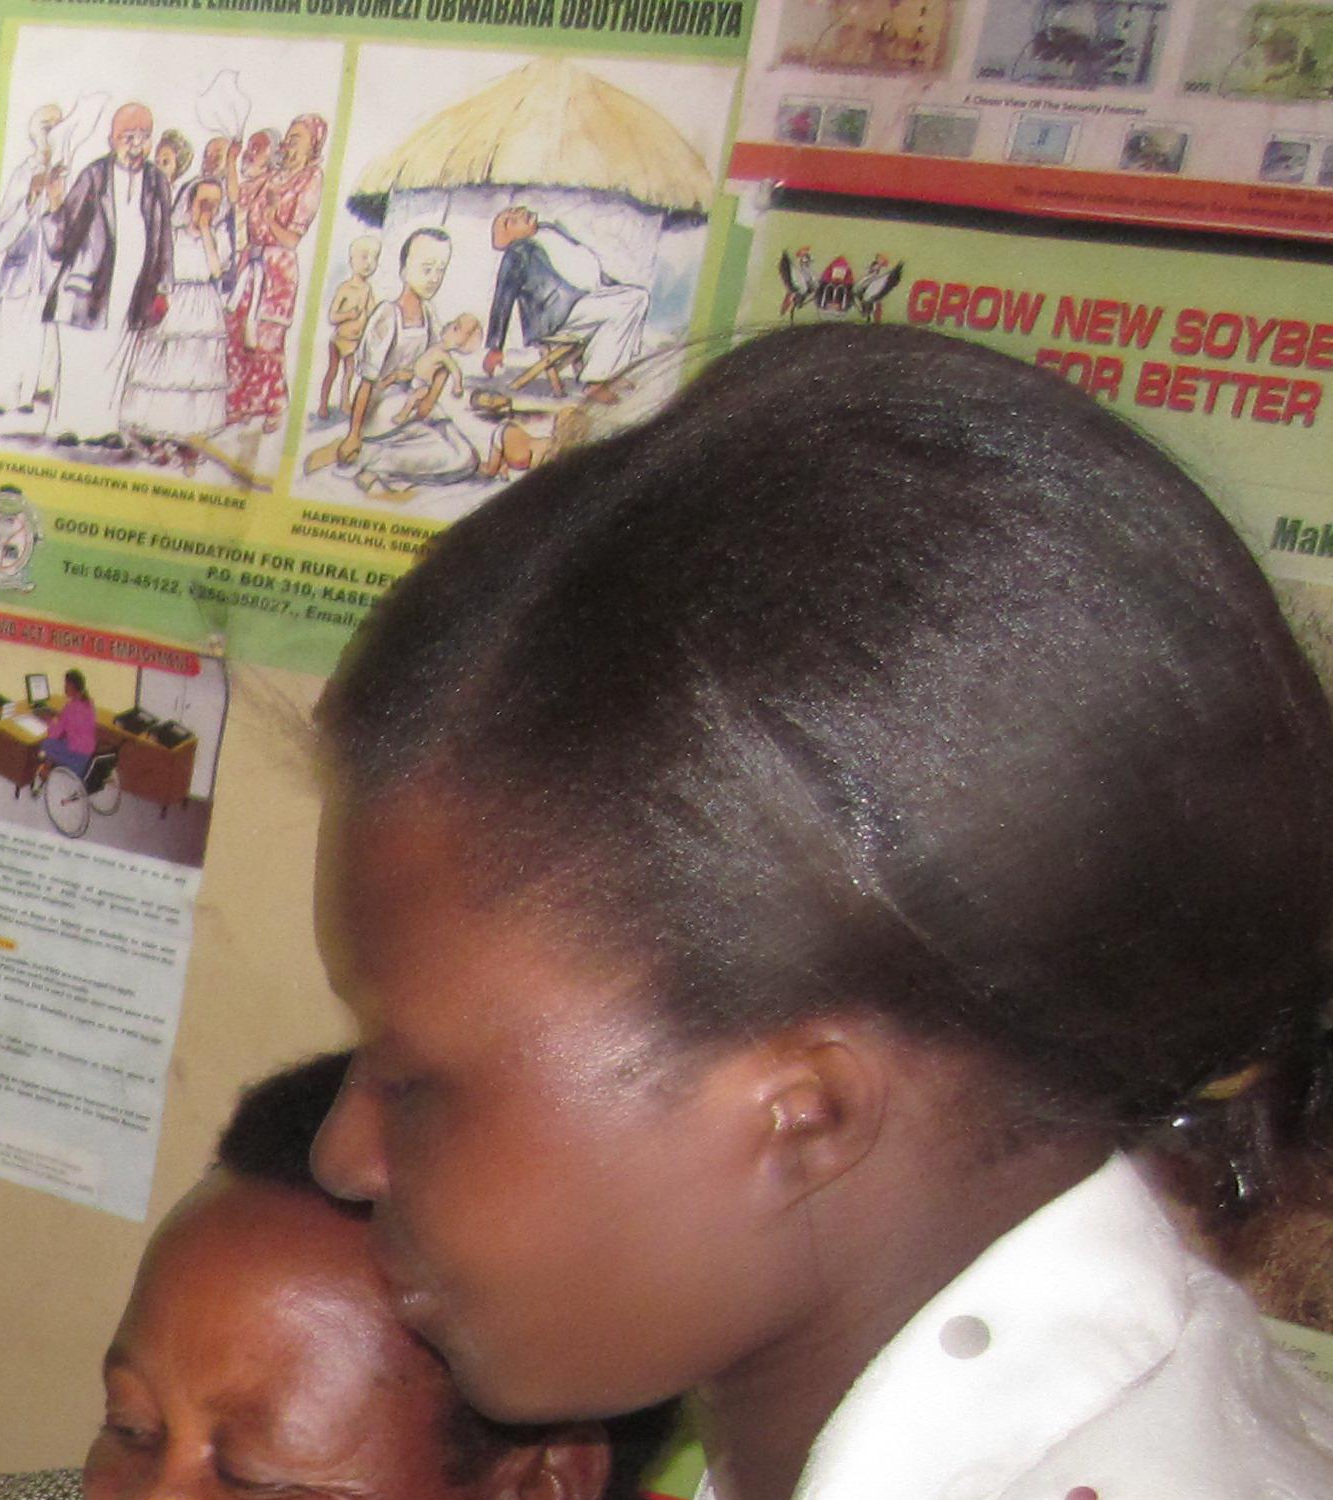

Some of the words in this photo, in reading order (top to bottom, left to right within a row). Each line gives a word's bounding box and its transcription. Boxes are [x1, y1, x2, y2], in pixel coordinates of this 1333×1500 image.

[906, 278, 1046, 336] GROW
[1051, 294, 1165, 350] NEW
[1170, 307, 1333, 372] SOYBE
[1134, 360, 1323, 428] BETTER
[54, 516, 99, 536] GOOD
[103, 525, 146, 546] HOPE
[150, 533, 256, 567] FOUNDATION
[260, 551, 296, 573] FOR
[300, 560, 360, 584] RURAL
[239, 571, 276, 591] BOX
